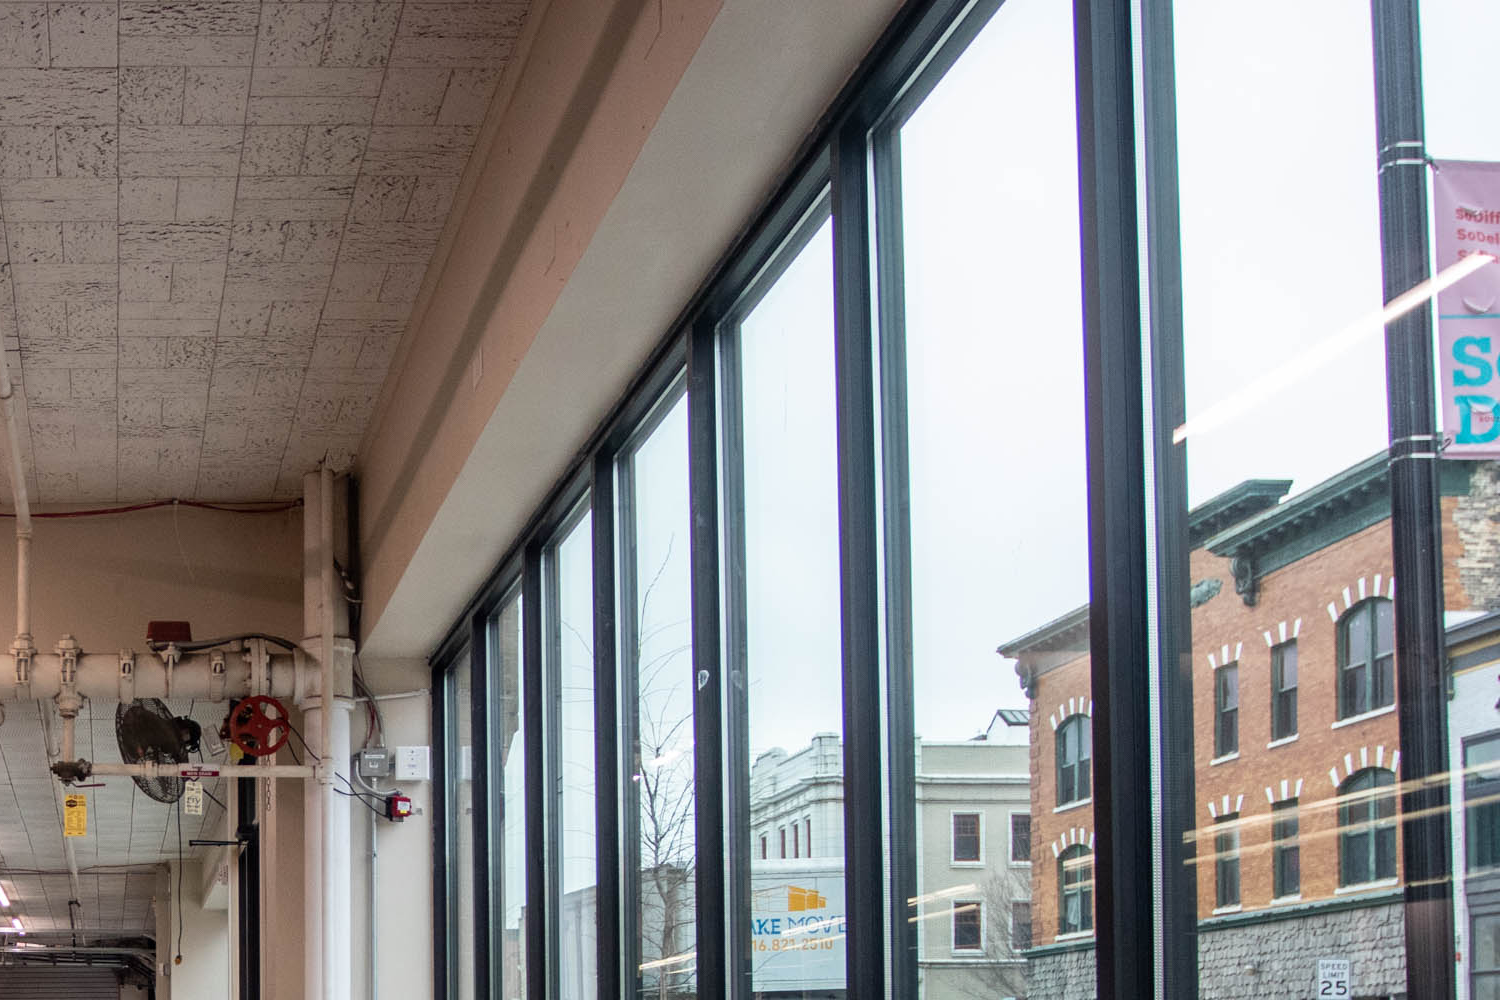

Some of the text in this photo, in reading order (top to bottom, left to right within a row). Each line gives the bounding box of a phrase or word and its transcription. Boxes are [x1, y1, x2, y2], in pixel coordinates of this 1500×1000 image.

[1452, 336, 1500, 387] S
[1323, 971, 1345, 979] LIMIT
[1320, 980, 1348, 996] 25
